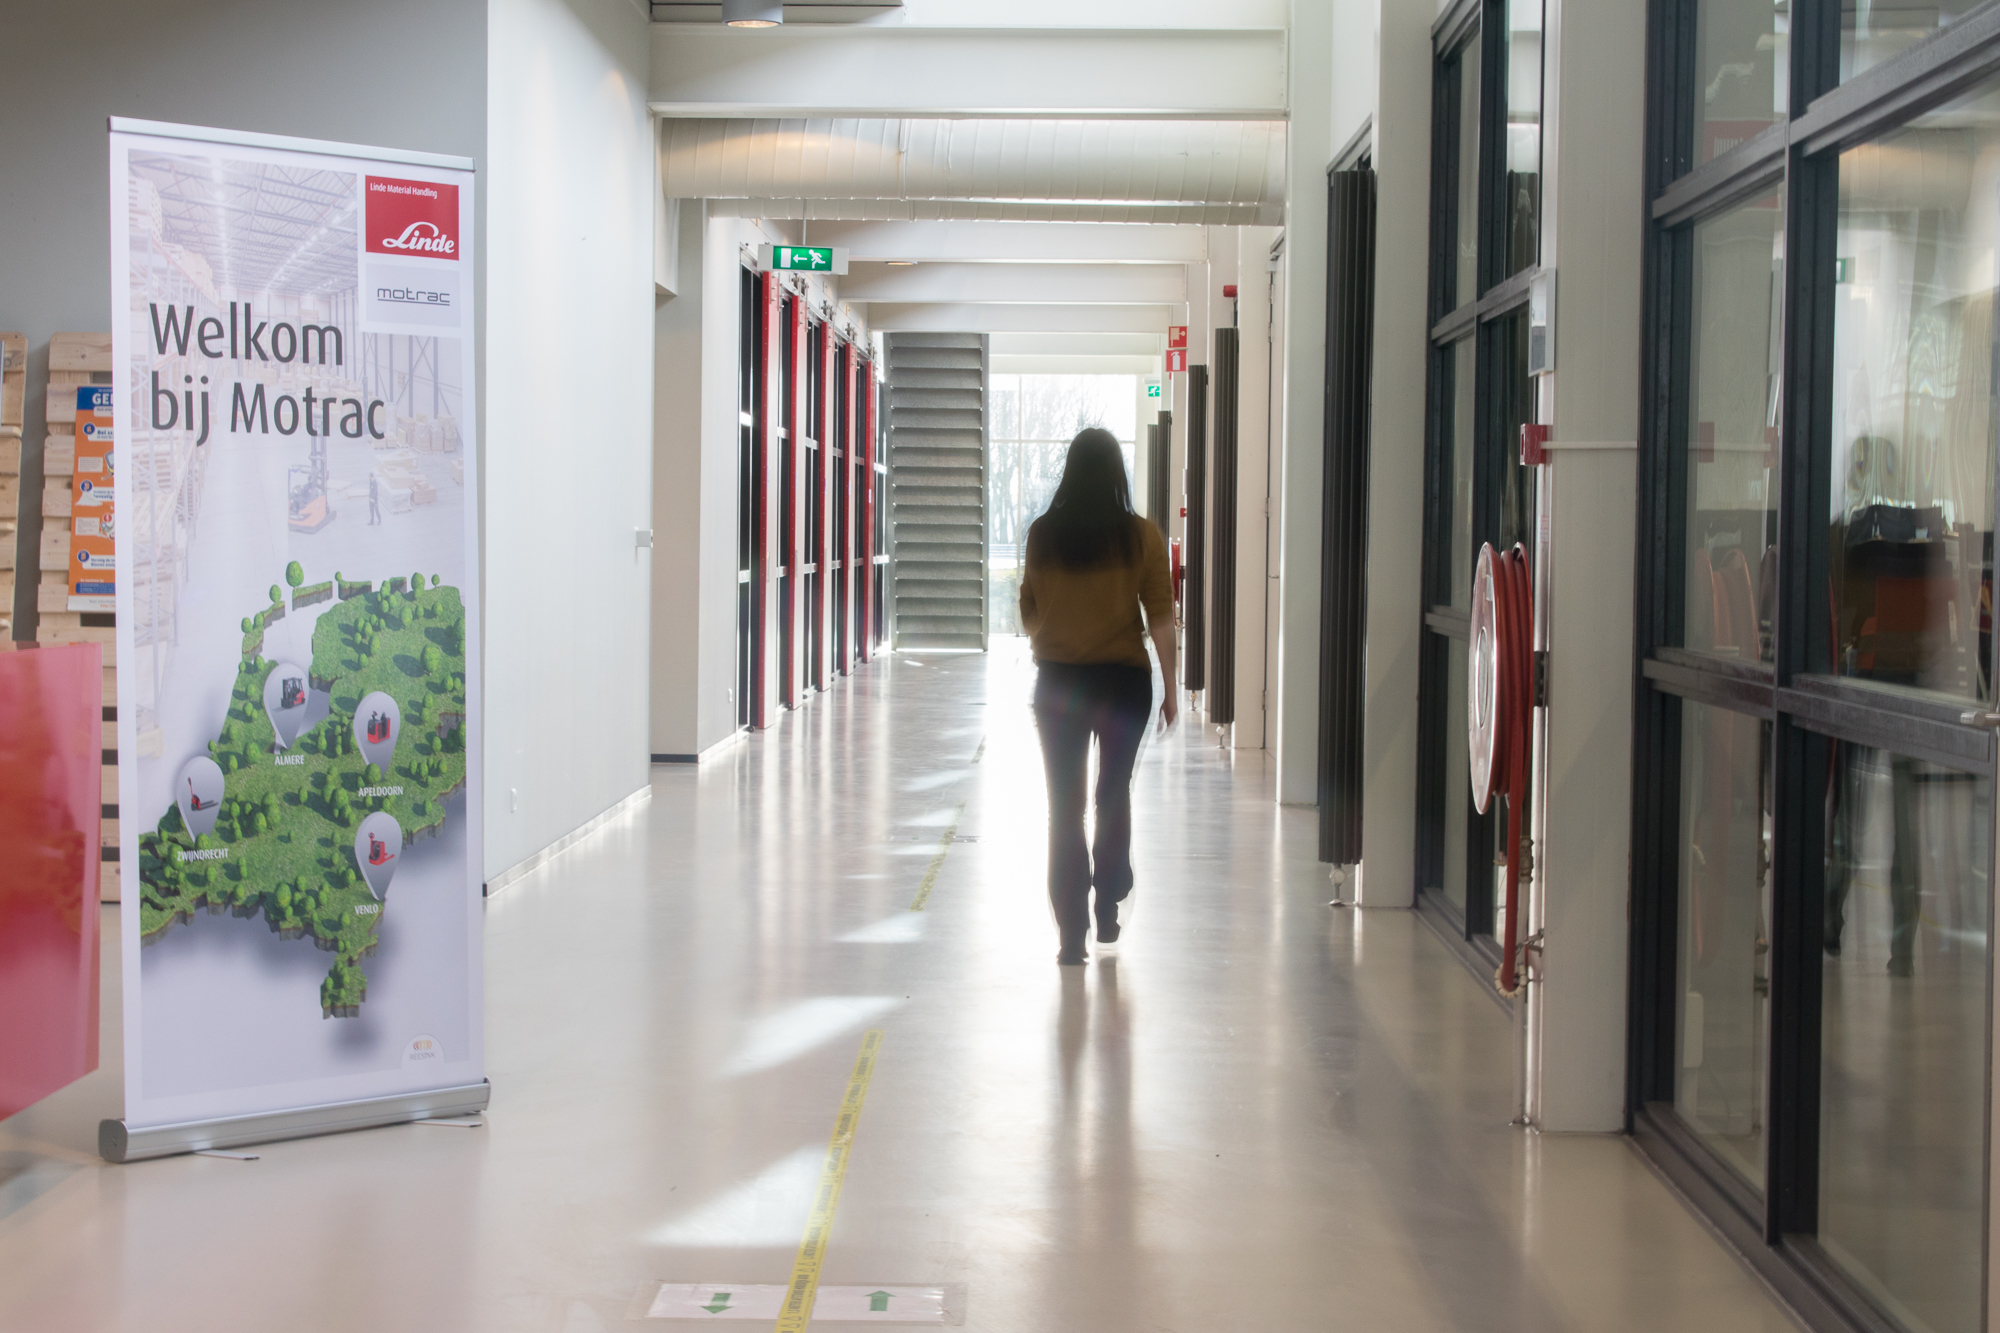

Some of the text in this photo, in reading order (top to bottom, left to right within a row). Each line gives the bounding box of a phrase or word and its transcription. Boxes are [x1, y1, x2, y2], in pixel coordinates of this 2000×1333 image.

[370, 182, 438, 200] Linde Material Handling
[382, 221, 455, 254] Linde
[377, 287, 451, 304] motrac
[149, 301, 343, 366] Welkom
[151, 370, 385, 447] bij Motrac
[274, 754, 305, 766] ALMERE
[358, 786, 404, 798] APELDOORN
[176, 848, 229, 863] ZWIJNDRECHT
[354, 903, 379, 915] VENLO
